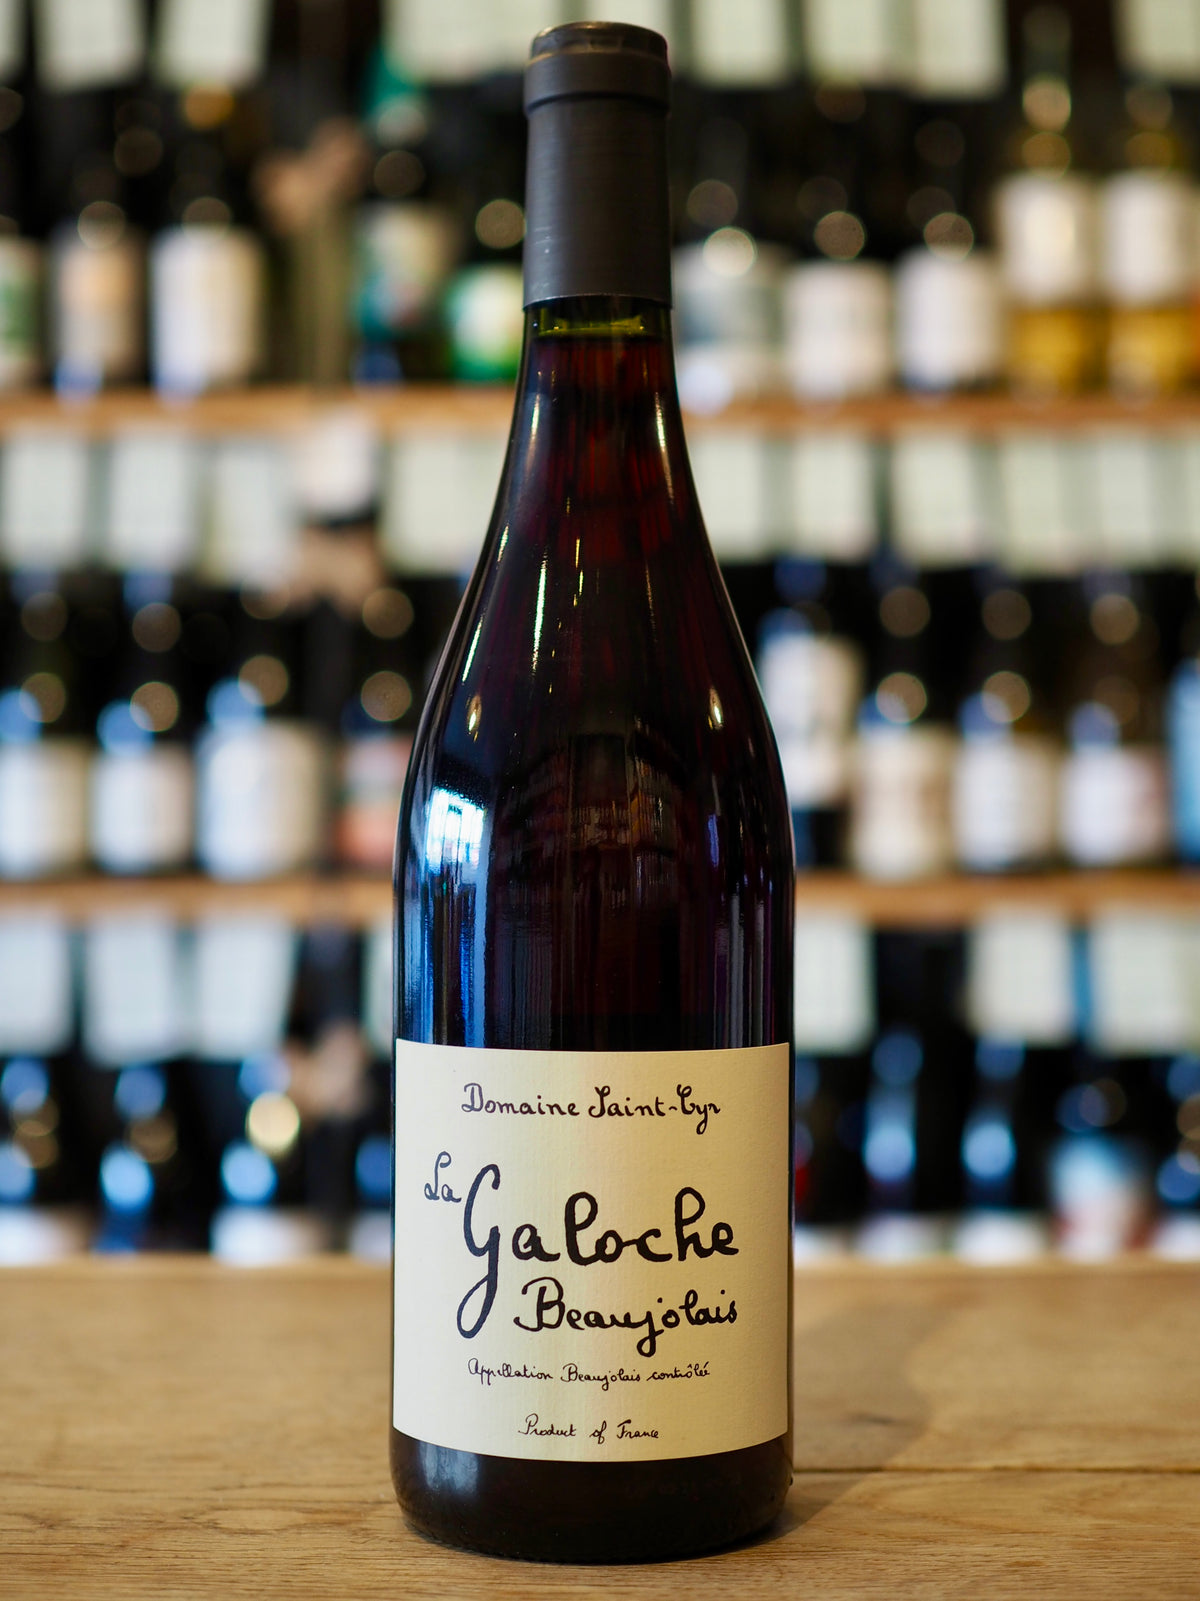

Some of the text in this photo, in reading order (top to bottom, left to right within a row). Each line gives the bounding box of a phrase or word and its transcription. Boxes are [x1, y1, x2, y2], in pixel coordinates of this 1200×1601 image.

[461, 1082, 721, 1136] Domaine Saint-Cyr
[424, 1150, 740, 1340] La Galoche
[513, 1276, 738, 1358] Beaujolais
[467, 1357, 554, 1387] Appellation
[560, 1362, 641, 1392] Beaujolais
[517, 1412, 660, 1445] Product of France
